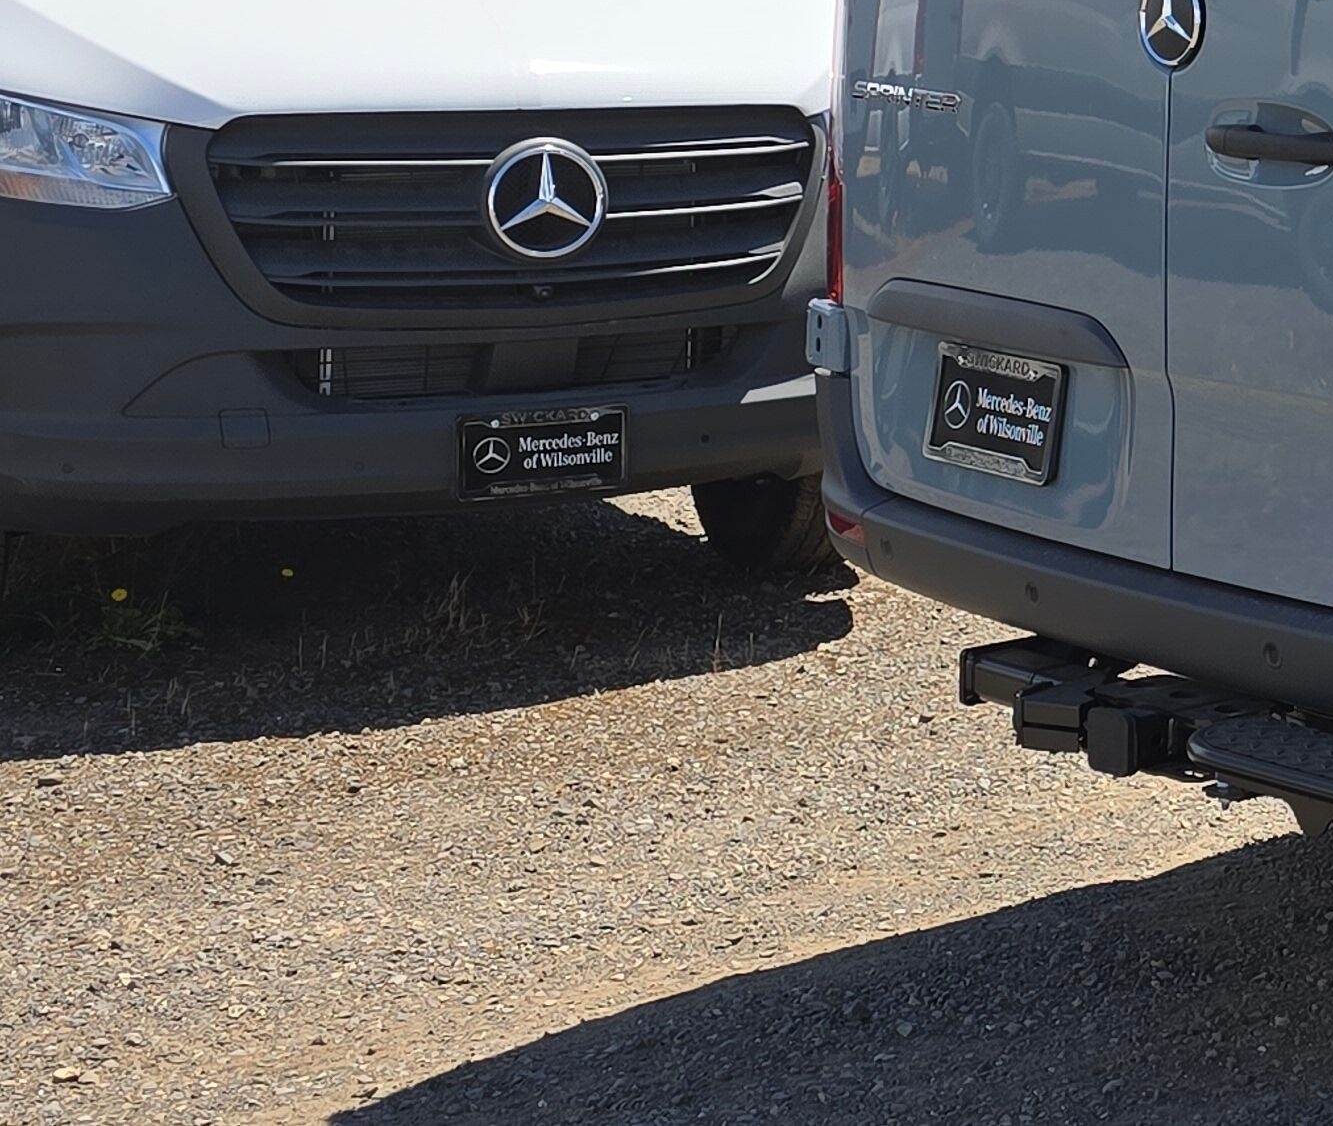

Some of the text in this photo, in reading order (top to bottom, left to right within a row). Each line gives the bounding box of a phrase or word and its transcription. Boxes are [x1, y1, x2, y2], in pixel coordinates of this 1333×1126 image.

[851, 80, 961, 113] SPRINTER
[976, 386, 1052, 423] Mercedes-Benz
[518, 430, 619, 453] Mercedes-Benz
[976, 413, 1044, 446] of Wilsonville
[523, 447, 613, 470] of Wilsonville
